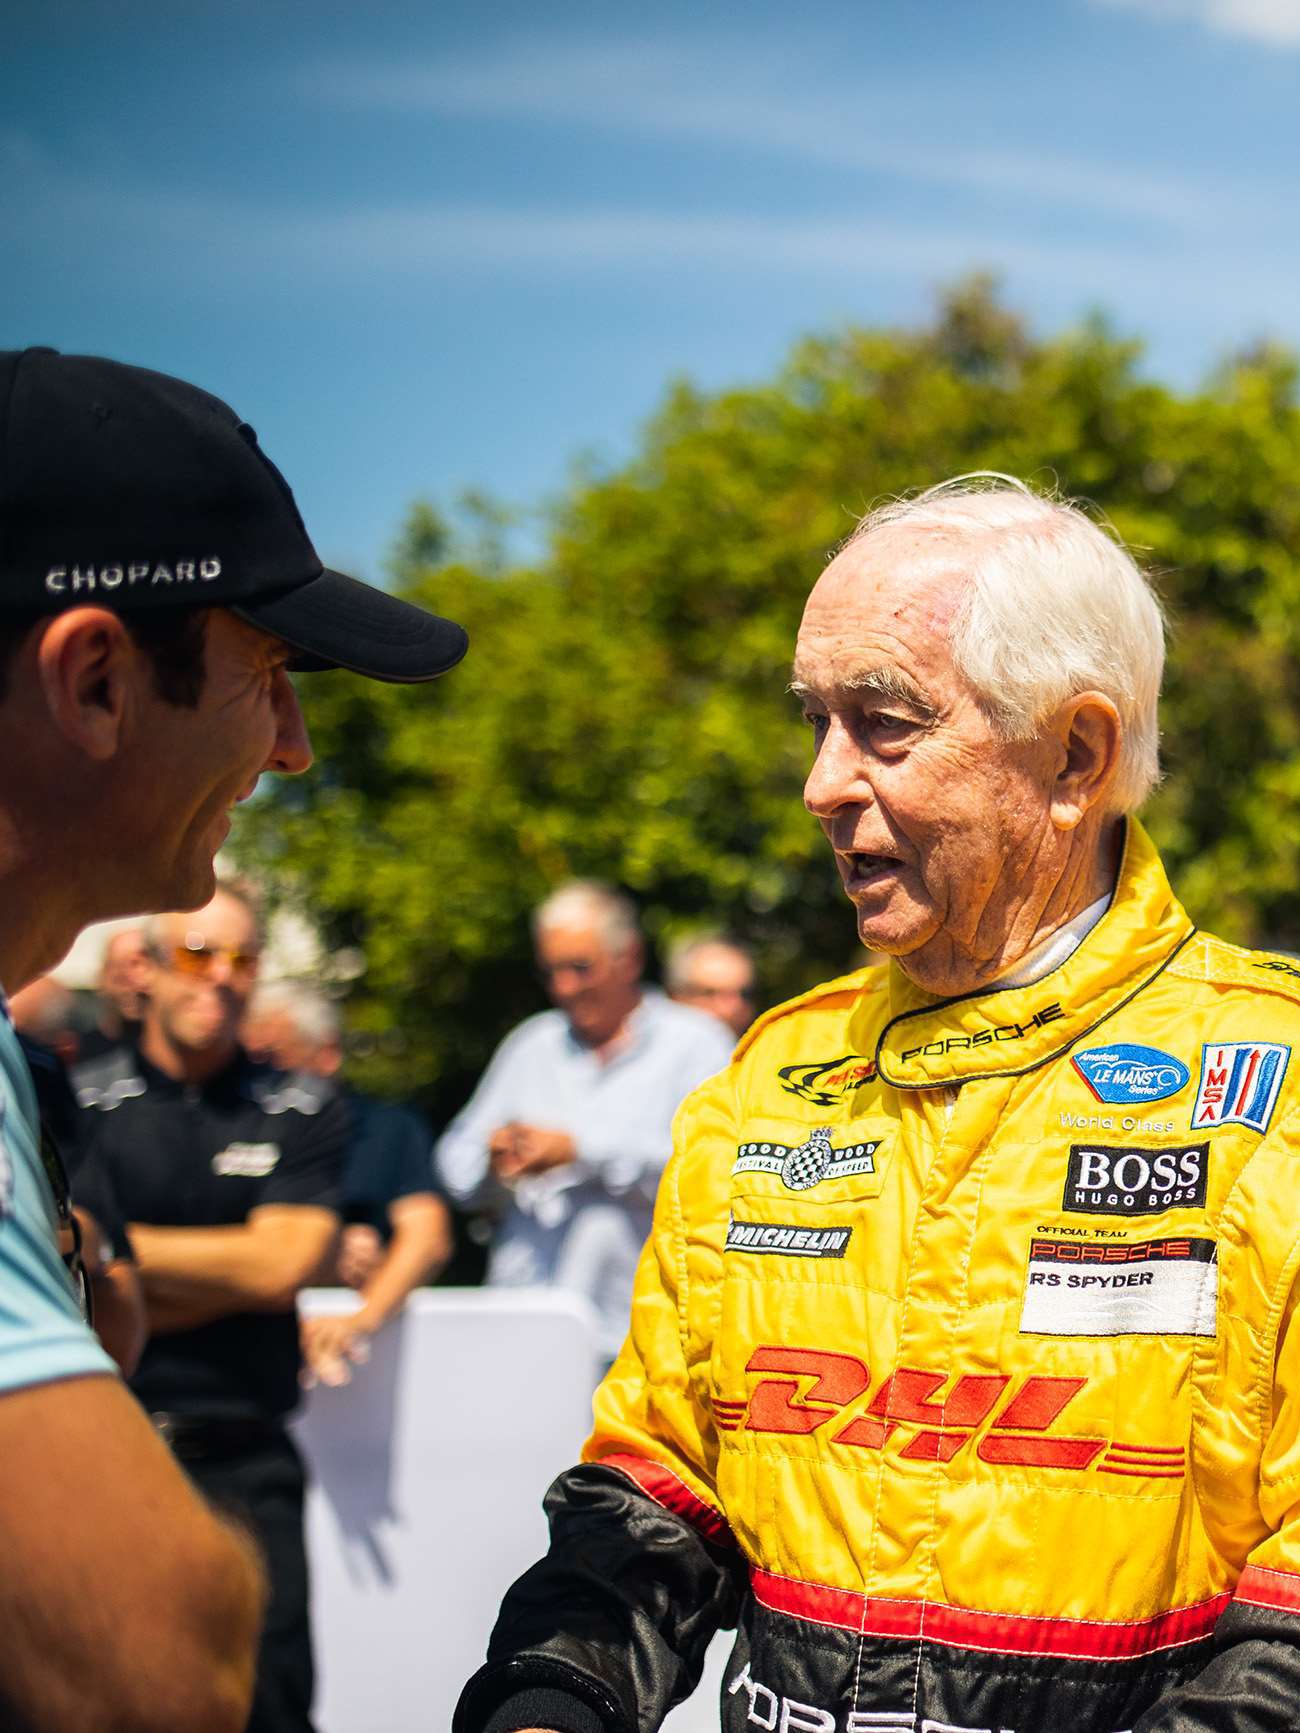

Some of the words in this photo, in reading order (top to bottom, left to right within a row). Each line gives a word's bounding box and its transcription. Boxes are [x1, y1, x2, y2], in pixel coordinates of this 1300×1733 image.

[45, 557, 221, 593] CHOPARD
[902, 1002, 1065, 1063] PORSCHE
[1078, 1052, 1120, 1062] American
[1094, 1070, 1113, 1083] LE
[1112, 1070, 1154, 1086] MANS
[1198, 1050, 1227, 1122] IMSA
[1128, 1085, 1160, 1096] Series
[1060, 1112, 1114, 1129] World
[1122, 1116, 1175, 1132] Class
[1075, 1151, 1201, 1192] BOSS
[1075, 1190, 1135, 1206] HUGO
[1149, 1187, 1196, 1205] BOSS
[728, 1226, 848, 1250] MICHELIN
[1037, 1226, 1089, 1236] OFFICIAL
[1094, 1229, 1128, 1237] TEAM
[1030, 1241, 1190, 1262] PORSCHE
[1029, 1272, 1061, 1287] RS
[1066, 1271, 1155, 1289] SPYDER
[745, 1344, 1108, 1470] DHL
